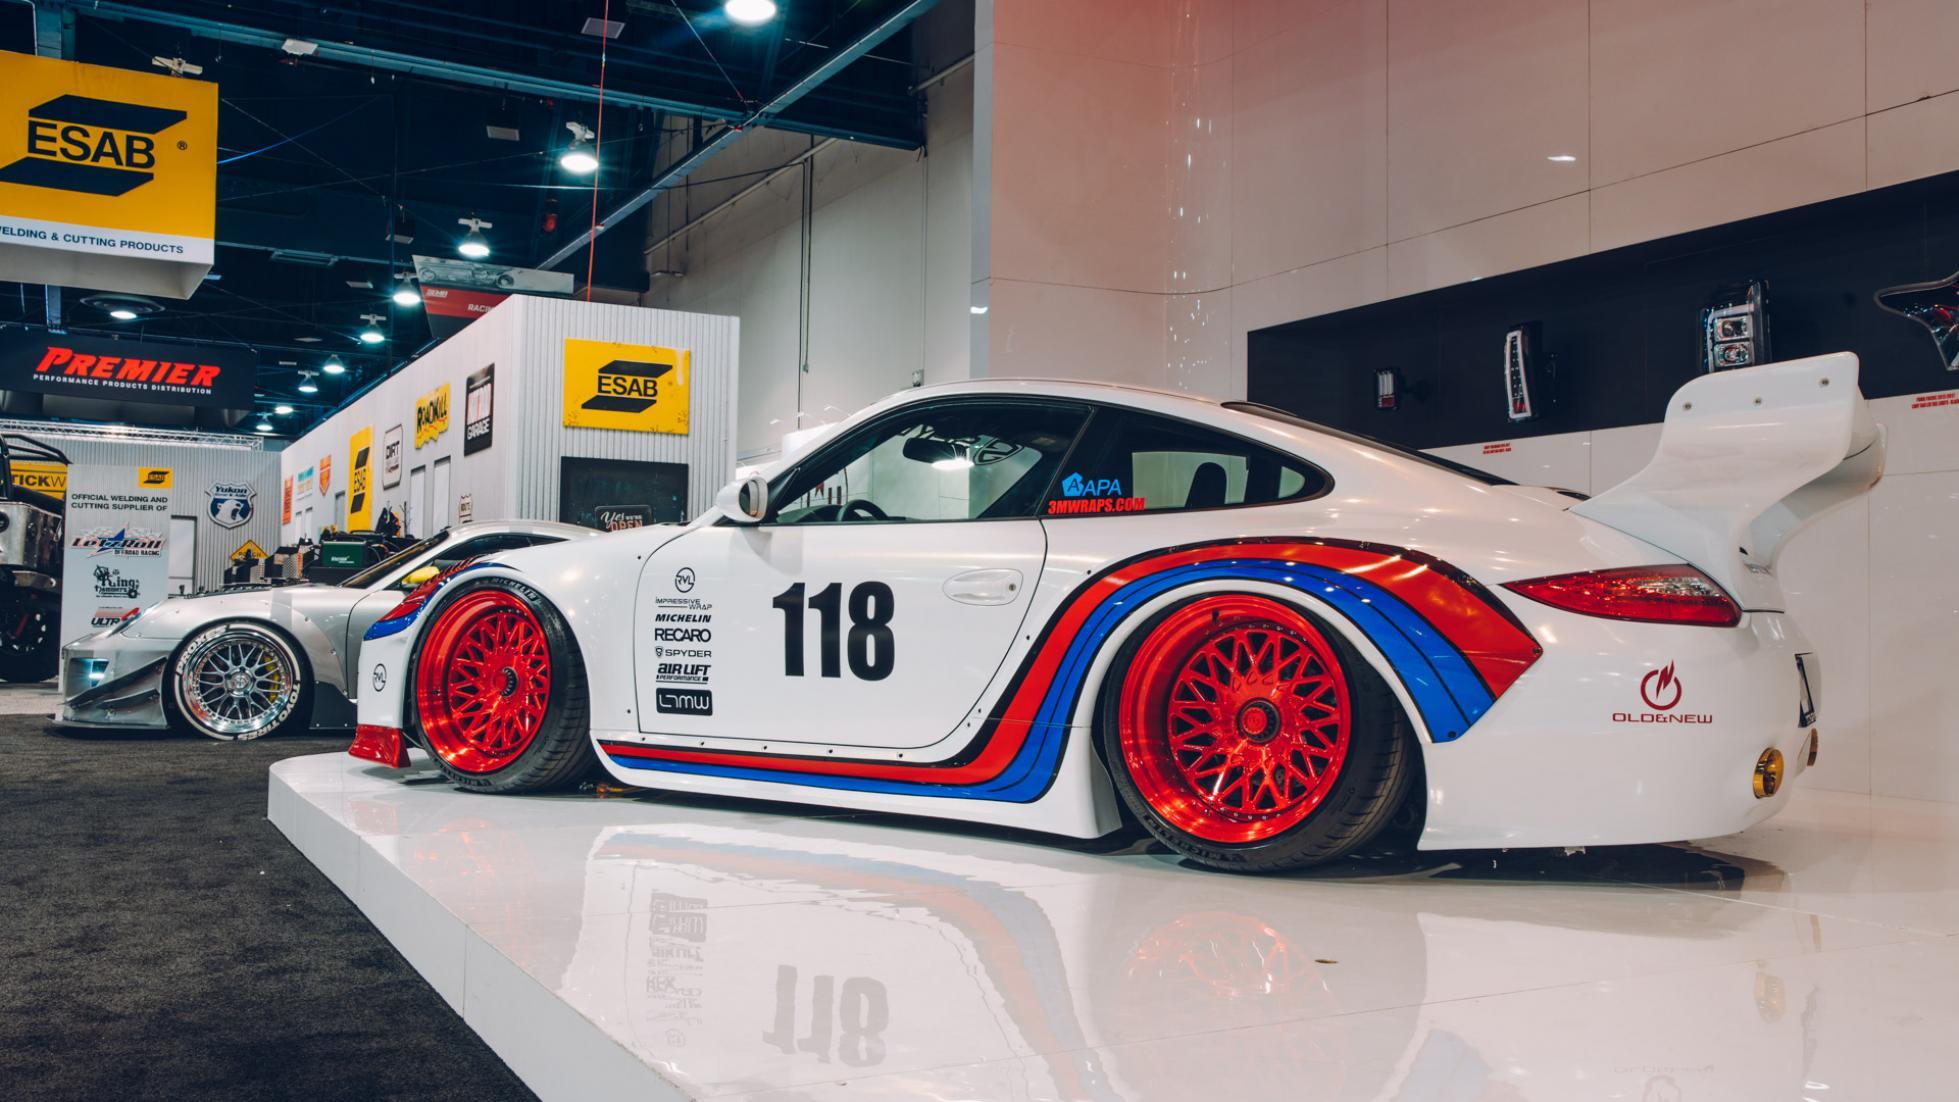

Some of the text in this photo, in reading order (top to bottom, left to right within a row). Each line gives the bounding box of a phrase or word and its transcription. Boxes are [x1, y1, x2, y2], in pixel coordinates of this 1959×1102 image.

[27, 119, 155, 169] ESAB
[51, 232, 60, 241] &
[63, 233, 116, 247] CUTTING
[120, 240, 184, 254] PRODUCTS
[35, 346, 220, 387] PREMIER
[33, 374, 212, 395] PERFORMANCE PRODUCTS DISTRIBUTION
[597, 373, 659, 398] ESAB
[215, 486, 248, 494] Yukon
[1082, 479, 1122, 496] APA
[71, 493, 109, 501] OFFICIAL
[111, 495, 149, 503] WELDING
[71, 502, 109, 510] CUTTING
[112, 503, 153, 511] SUPPLIER
[1048, 496, 1145, 514] 3MWRAPS.COM
[655, 614, 712, 623] MICHELIN
[655, 628, 711, 642] RECARO
[772, 581, 896, 681] 118
[665, 649, 712, 658] SPYDER
[1612, 713, 1713, 724] OLD&NEW
